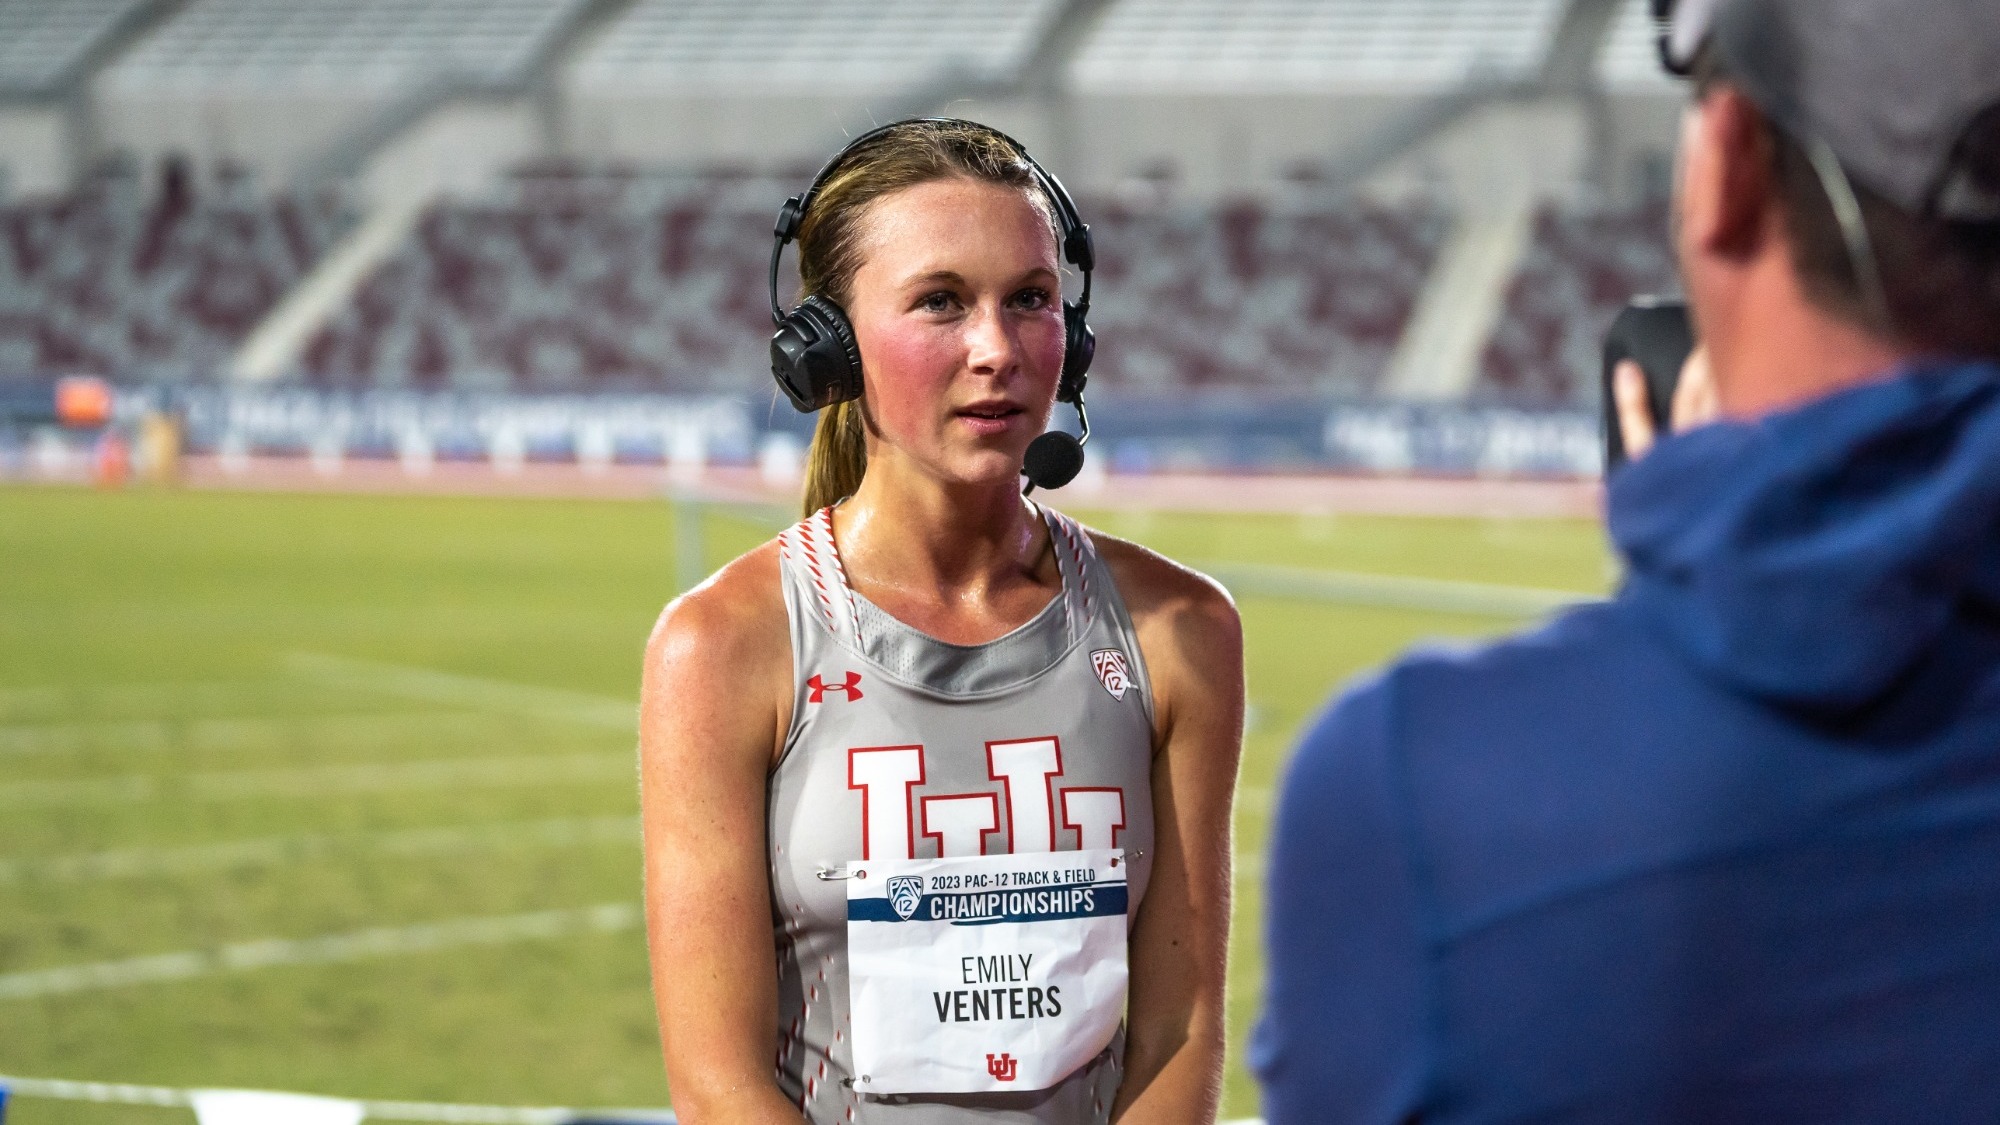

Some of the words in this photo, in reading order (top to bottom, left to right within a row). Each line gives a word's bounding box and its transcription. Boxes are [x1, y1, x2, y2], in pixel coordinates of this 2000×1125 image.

[1108, 676, 1123, 691] 12
[931, 876, 961, 890] 2023
[965, 873, 1008, 888] PAC-12
[1012, 871, 1050, 886] TRACK
[1053, 871, 1062, 883] &
[1065, 868, 1096, 883] FIELD
[899, 899, 913, 912] 12
[930, 889, 1095, 919] CHAMPIONSHIPS
[961, 953, 1033, 984] EMILY
[933, 985, 1062, 1022] VENTERS
